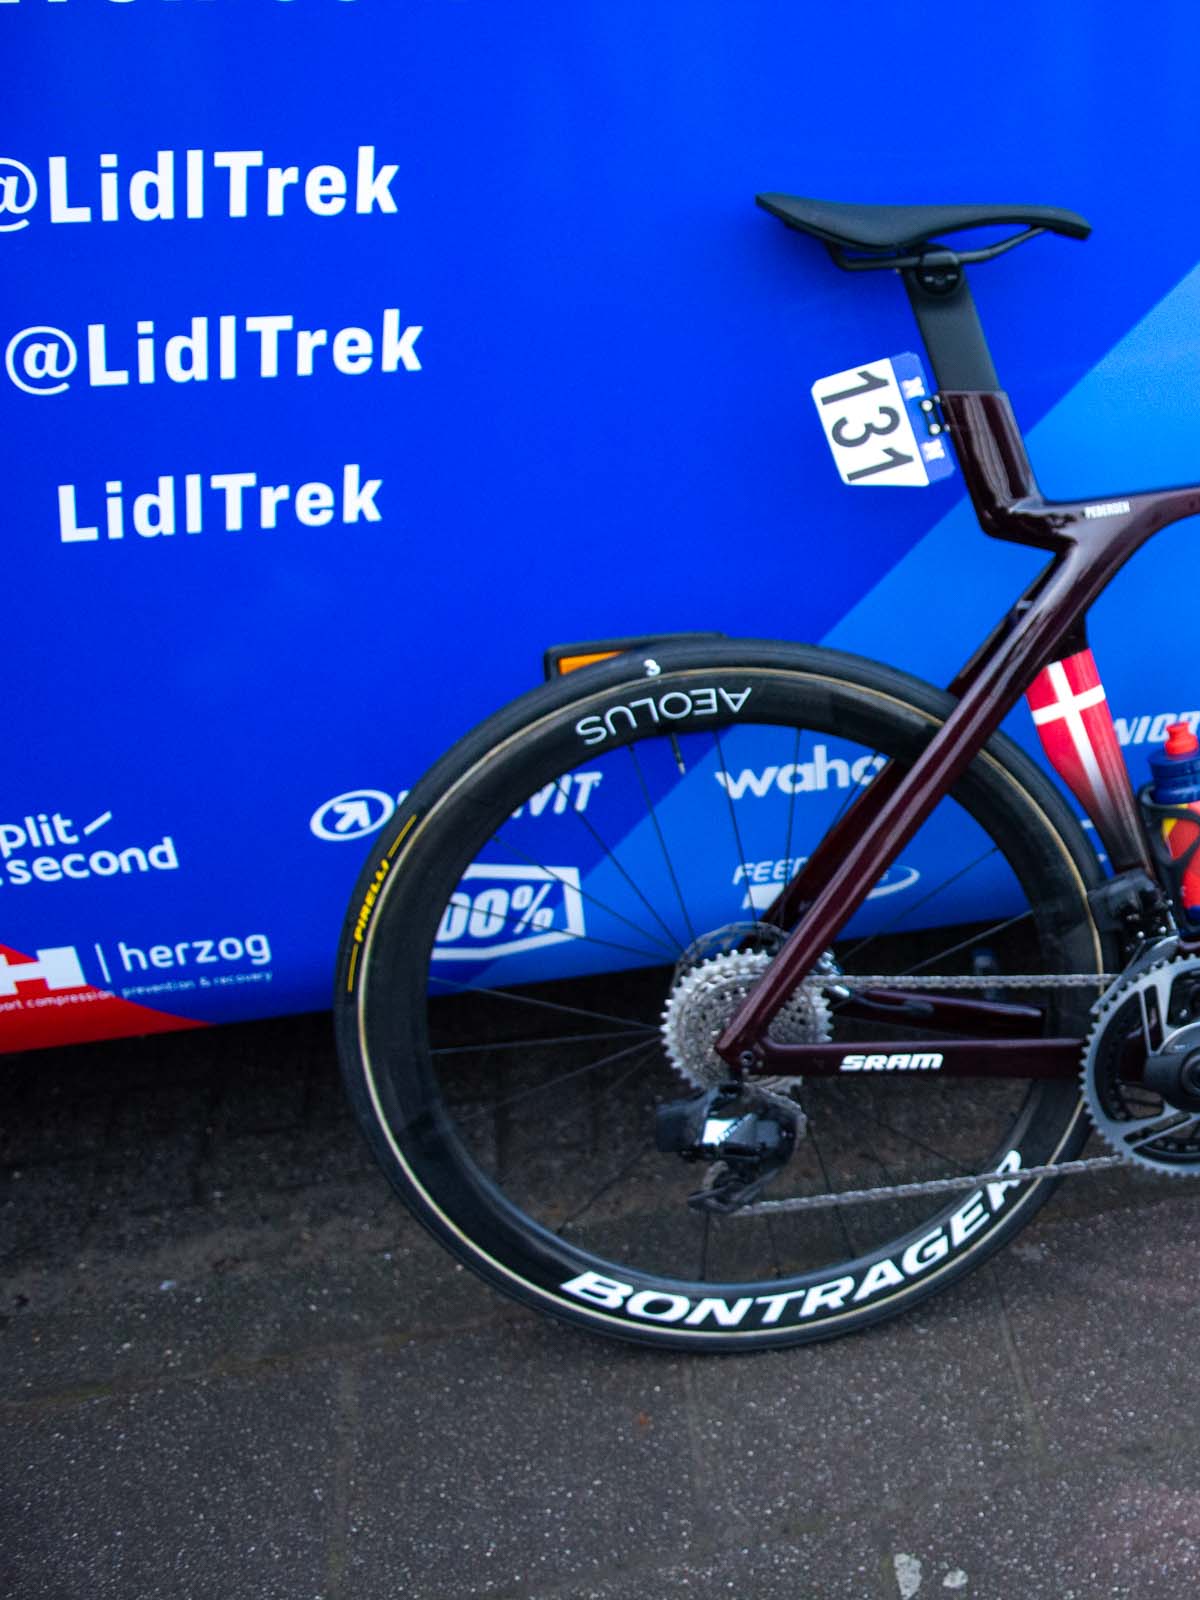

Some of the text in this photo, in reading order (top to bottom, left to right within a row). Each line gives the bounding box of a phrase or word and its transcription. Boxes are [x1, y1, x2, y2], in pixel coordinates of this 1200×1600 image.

[0, 145, 399, 232] @LidlTrek
[5, 308, 423, 395] @LidlTrek
[820, 370, 915, 481] 131
[57, 463, 382, 543] LidlTrek
[575, 686, 752, 745] AEOLUS
[512, 771, 602, 818] VIT
[715, 744, 888, 799] waho
[0, 813, 79, 859] plit
[6, 836, 179, 885] second
[354, 858, 389, 942] PIRELLI
[436, 883, 556, 944] 00%
[118, 933, 271, 971] herzog
[26, 989, 116, 1009] compression
[121, 979, 197, 999] prevention
[213, 969, 273, 987] recovery
[840, 1053, 944, 1071] SRAM
